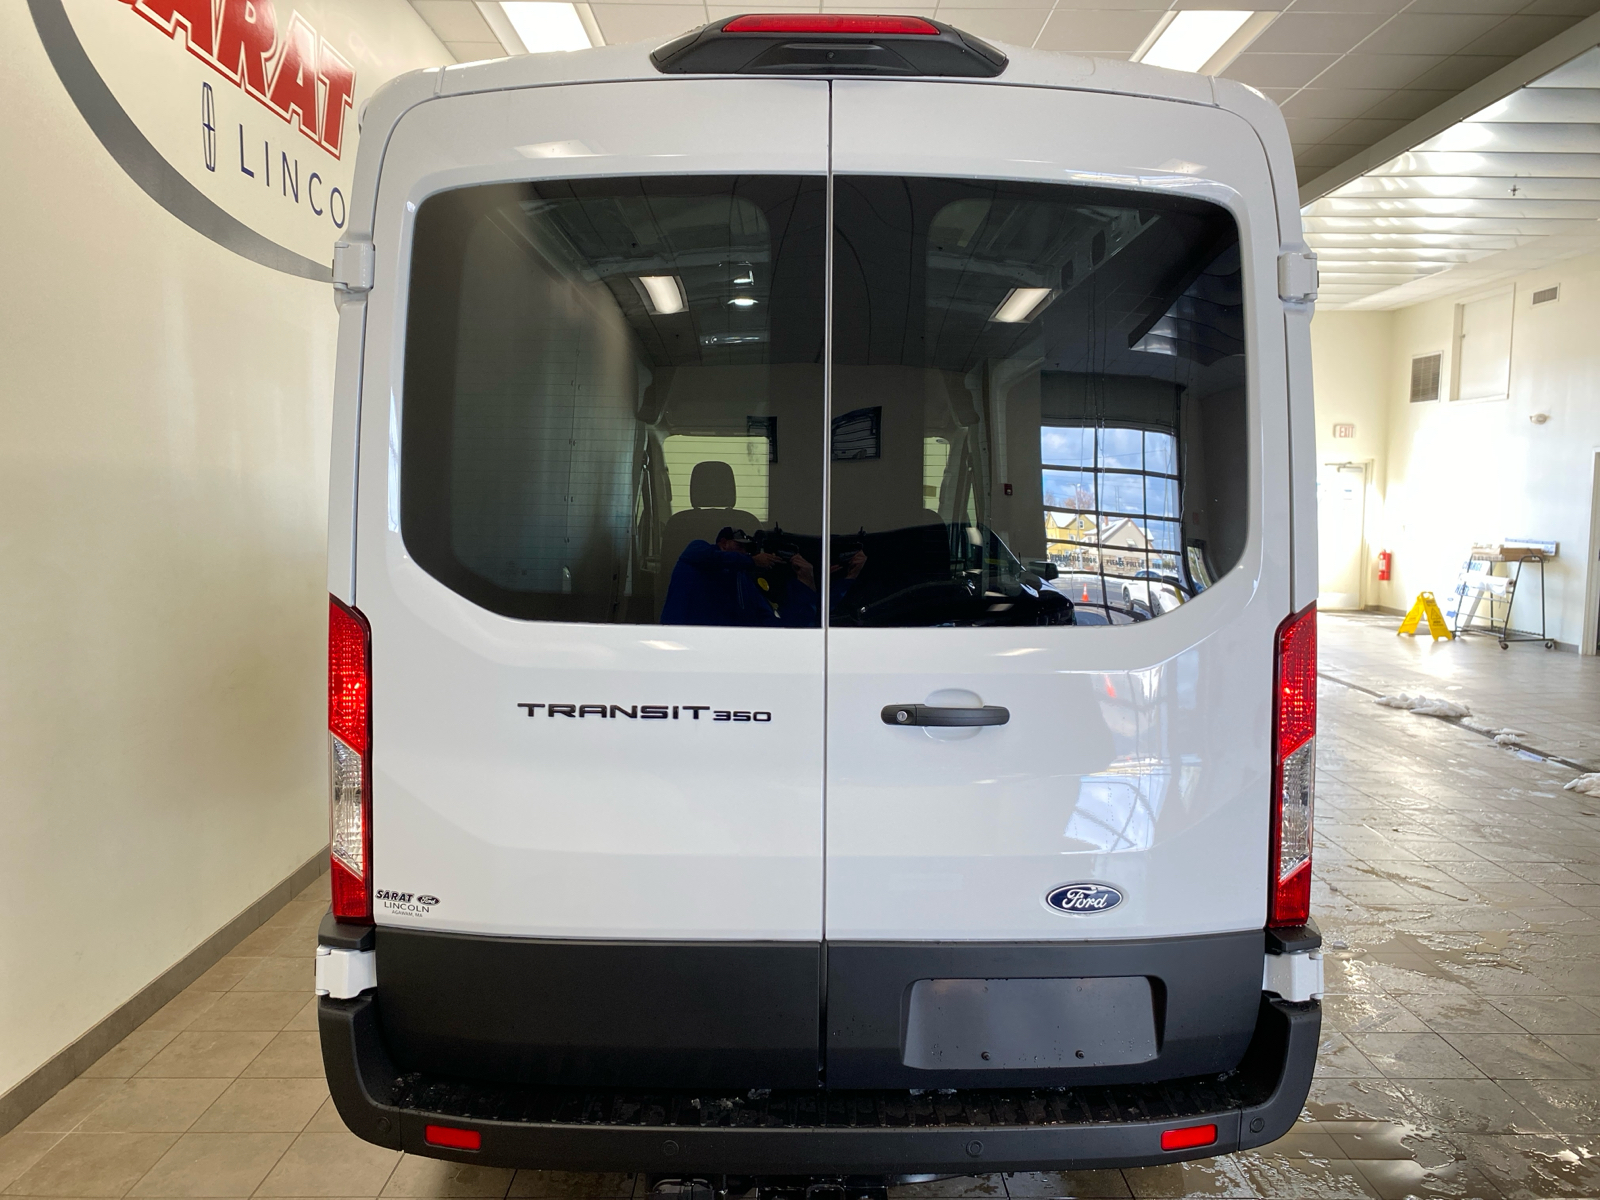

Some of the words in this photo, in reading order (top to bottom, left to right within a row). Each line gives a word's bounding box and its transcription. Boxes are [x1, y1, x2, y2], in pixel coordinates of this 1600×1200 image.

[118, 0, 356, 160] RAT
[1338, 426, 1355, 438] EXIT
[517, 702, 711, 720] TRANSIT
[712, 710, 772, 722] 350
[375, 888, 415, 903] SARAT
[1062, 888, 1108, 908] Ford
[384, 901, 430, 913] LINCOLN
